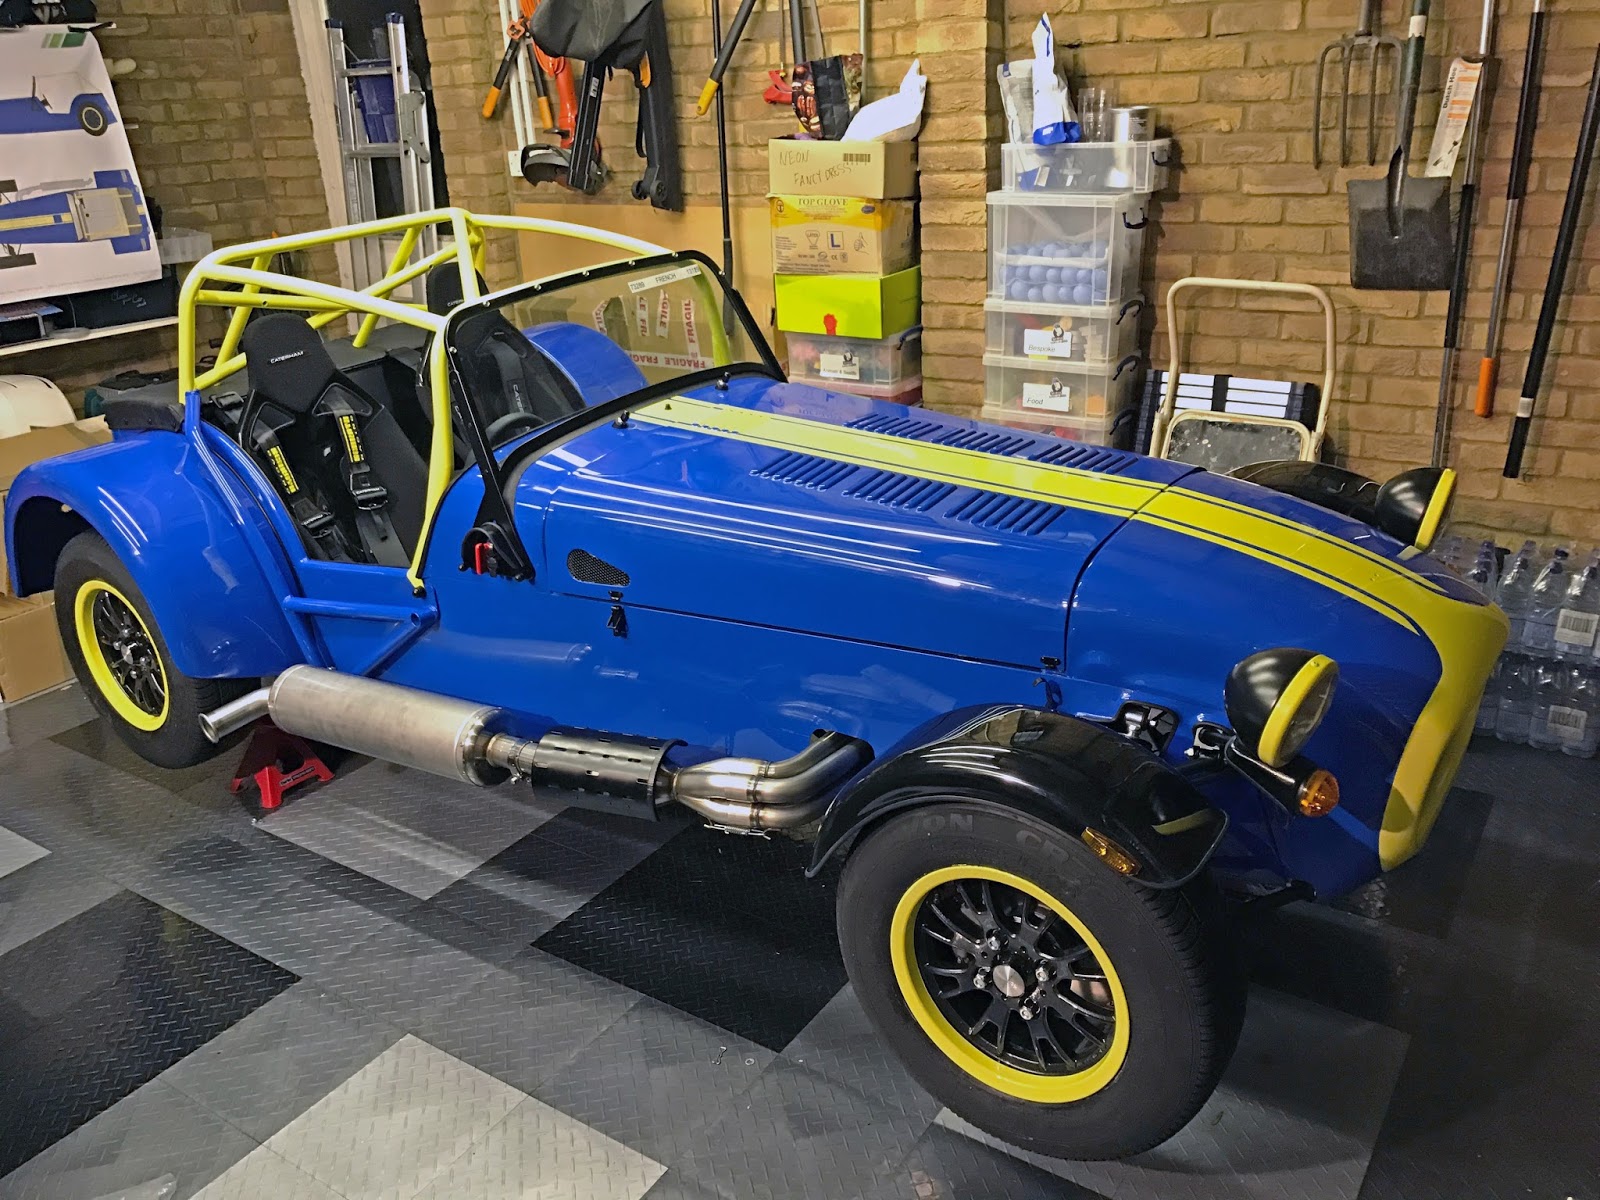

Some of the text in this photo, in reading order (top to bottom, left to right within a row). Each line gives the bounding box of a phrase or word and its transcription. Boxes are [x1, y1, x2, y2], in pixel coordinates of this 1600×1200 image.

[1443, 84, 1452, 108] Dutch
[779, 150, 810, 166] NEON
[794, 163, 852, 187] FANCY DRESS
[798, 198, 849, 206] TOP GLOVE
[830, 233, 841, 248] L
[655, 272, 677, 284] FRENCH
[270, 350, 304, 364] CATERHAM
[664, 356, 706, 369] FRAGILE
[1026, 397, 1043, 405] Food
